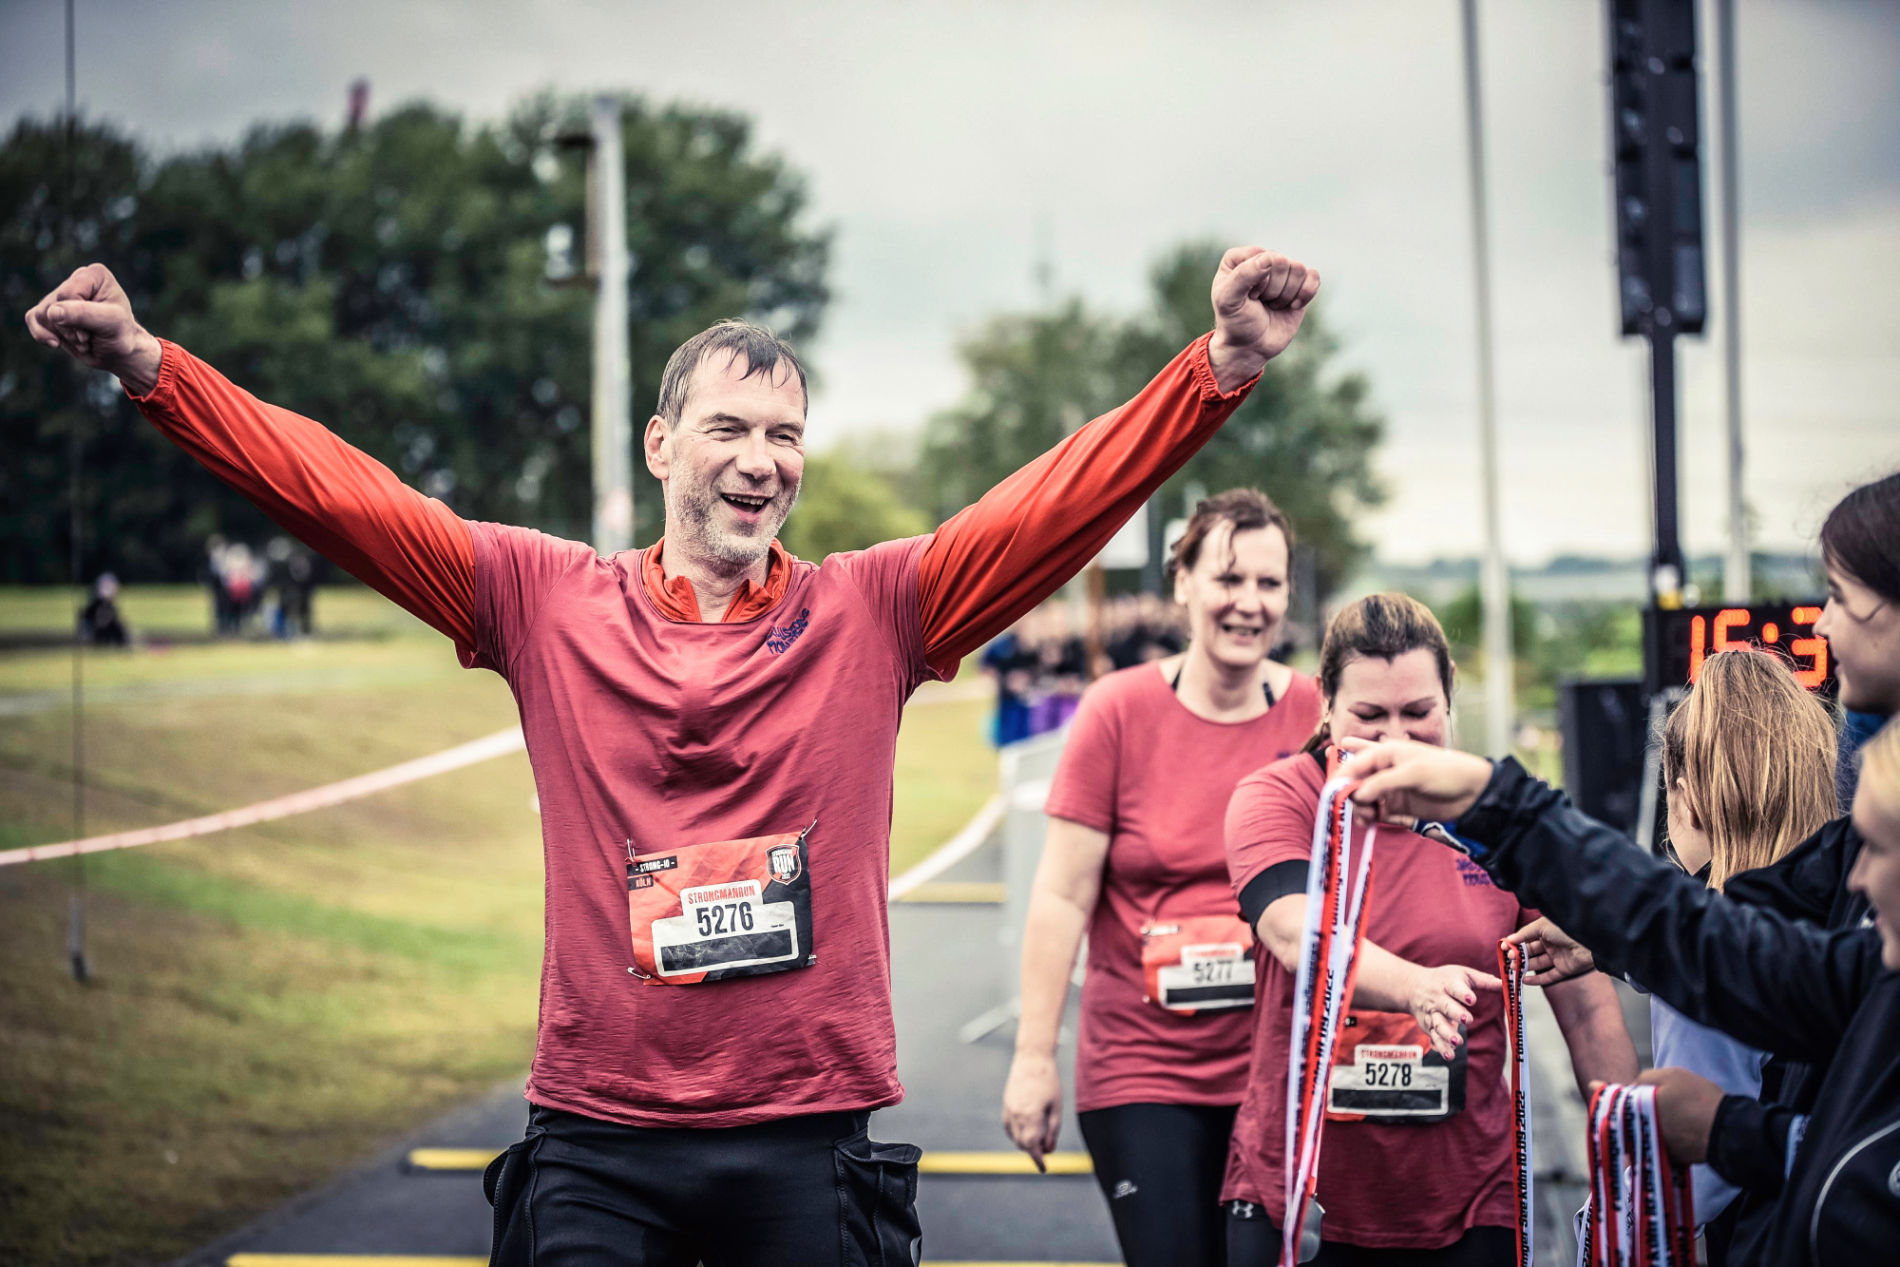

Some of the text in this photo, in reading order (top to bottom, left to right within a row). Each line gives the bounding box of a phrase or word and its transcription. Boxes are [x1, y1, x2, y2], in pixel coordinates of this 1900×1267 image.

[773, 854, 795, 874] RUN
[688, 885, 756, 905] STRONGMANRUN
[696, 901, 754, 937] 5276
[1193, 960, 1233, 983] 5277
[1365, 1063, 1412, 1087] 5278
